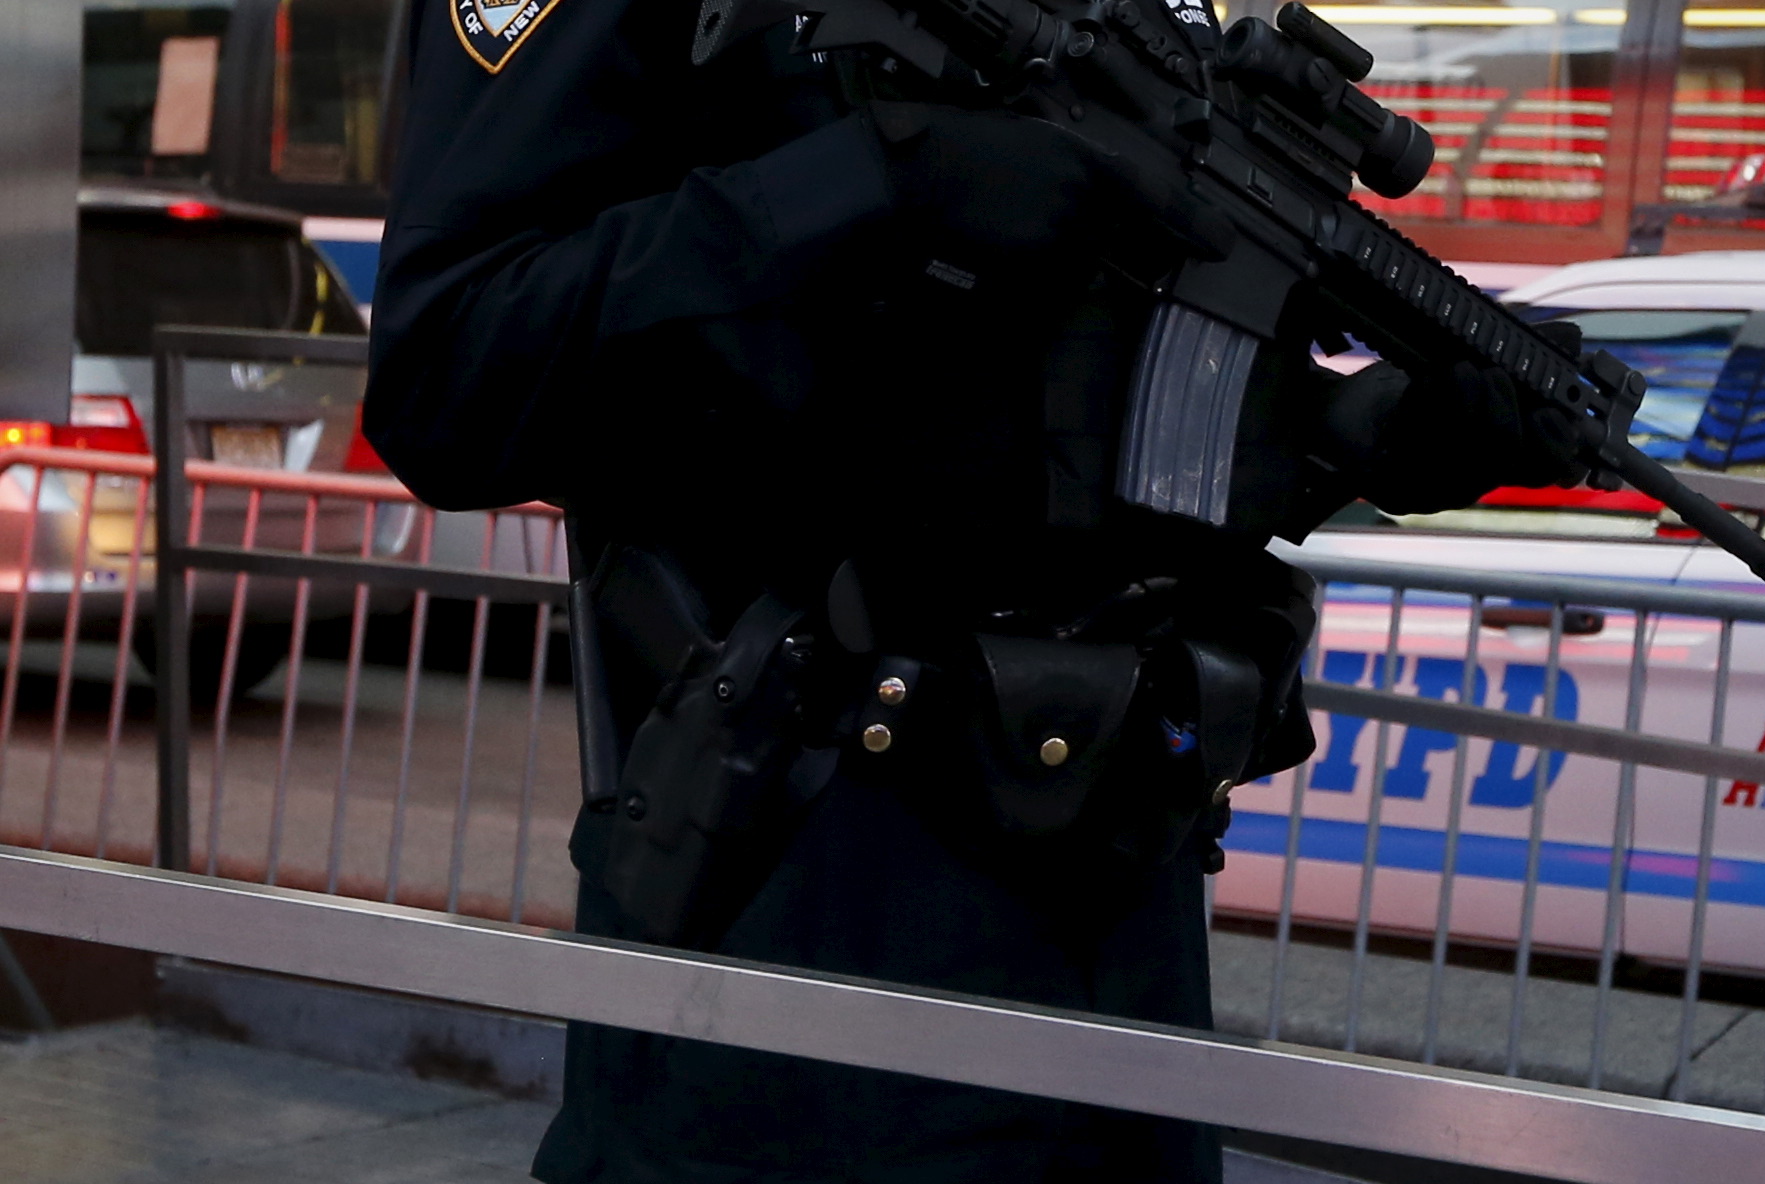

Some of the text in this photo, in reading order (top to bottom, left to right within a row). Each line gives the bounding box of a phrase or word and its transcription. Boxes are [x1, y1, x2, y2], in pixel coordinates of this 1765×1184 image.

[464, 12, 484, 35] OF
[503, 0, 540, 42] NEW
[1300, 649, 1580, 810] YPD
